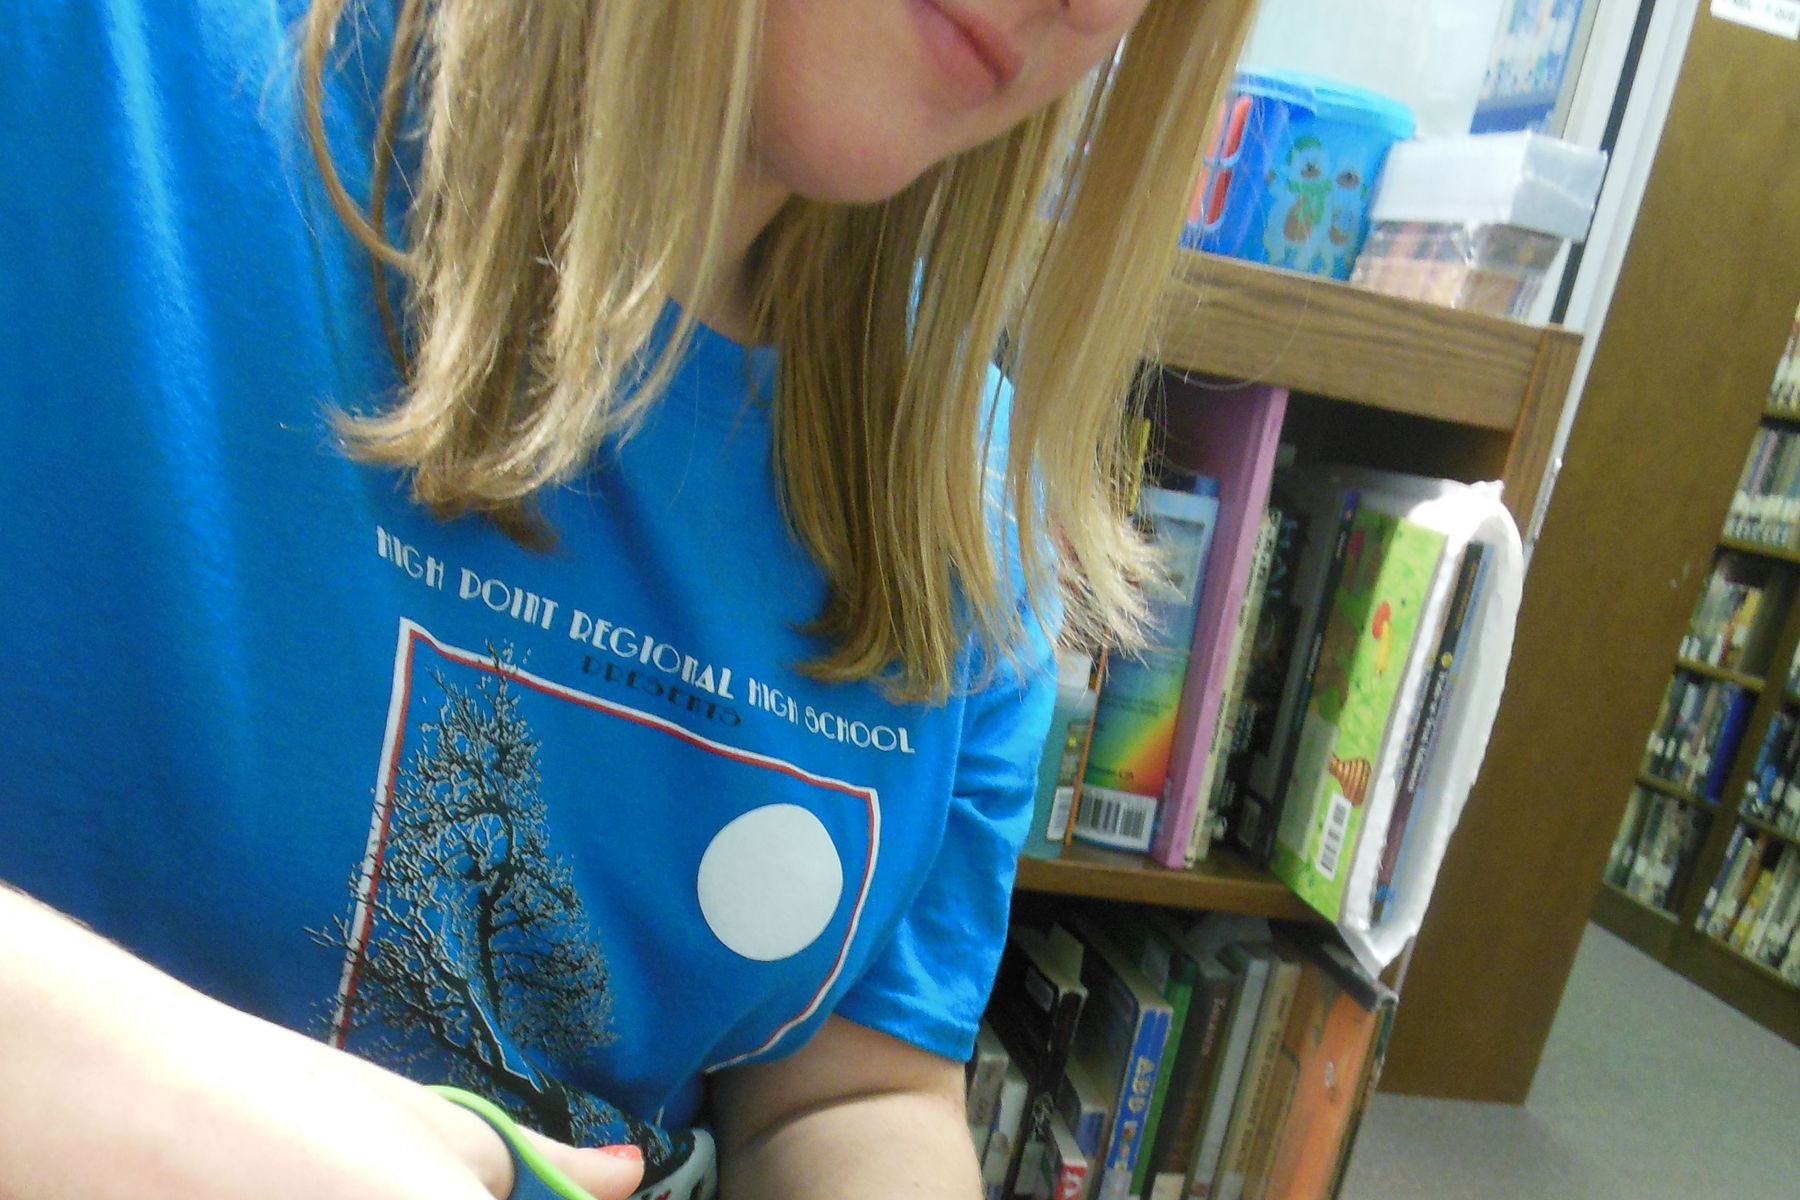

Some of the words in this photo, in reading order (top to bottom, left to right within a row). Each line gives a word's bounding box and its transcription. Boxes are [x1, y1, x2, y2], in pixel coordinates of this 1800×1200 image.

[376, 525, 444, 591] HIGH
[459, 567, 559, 630] POINT
[568, 609, 734, 700] REGIONAL
[749, 677, 799, 725] HIGH
[804, 705, 916, 754] SCHOOL
